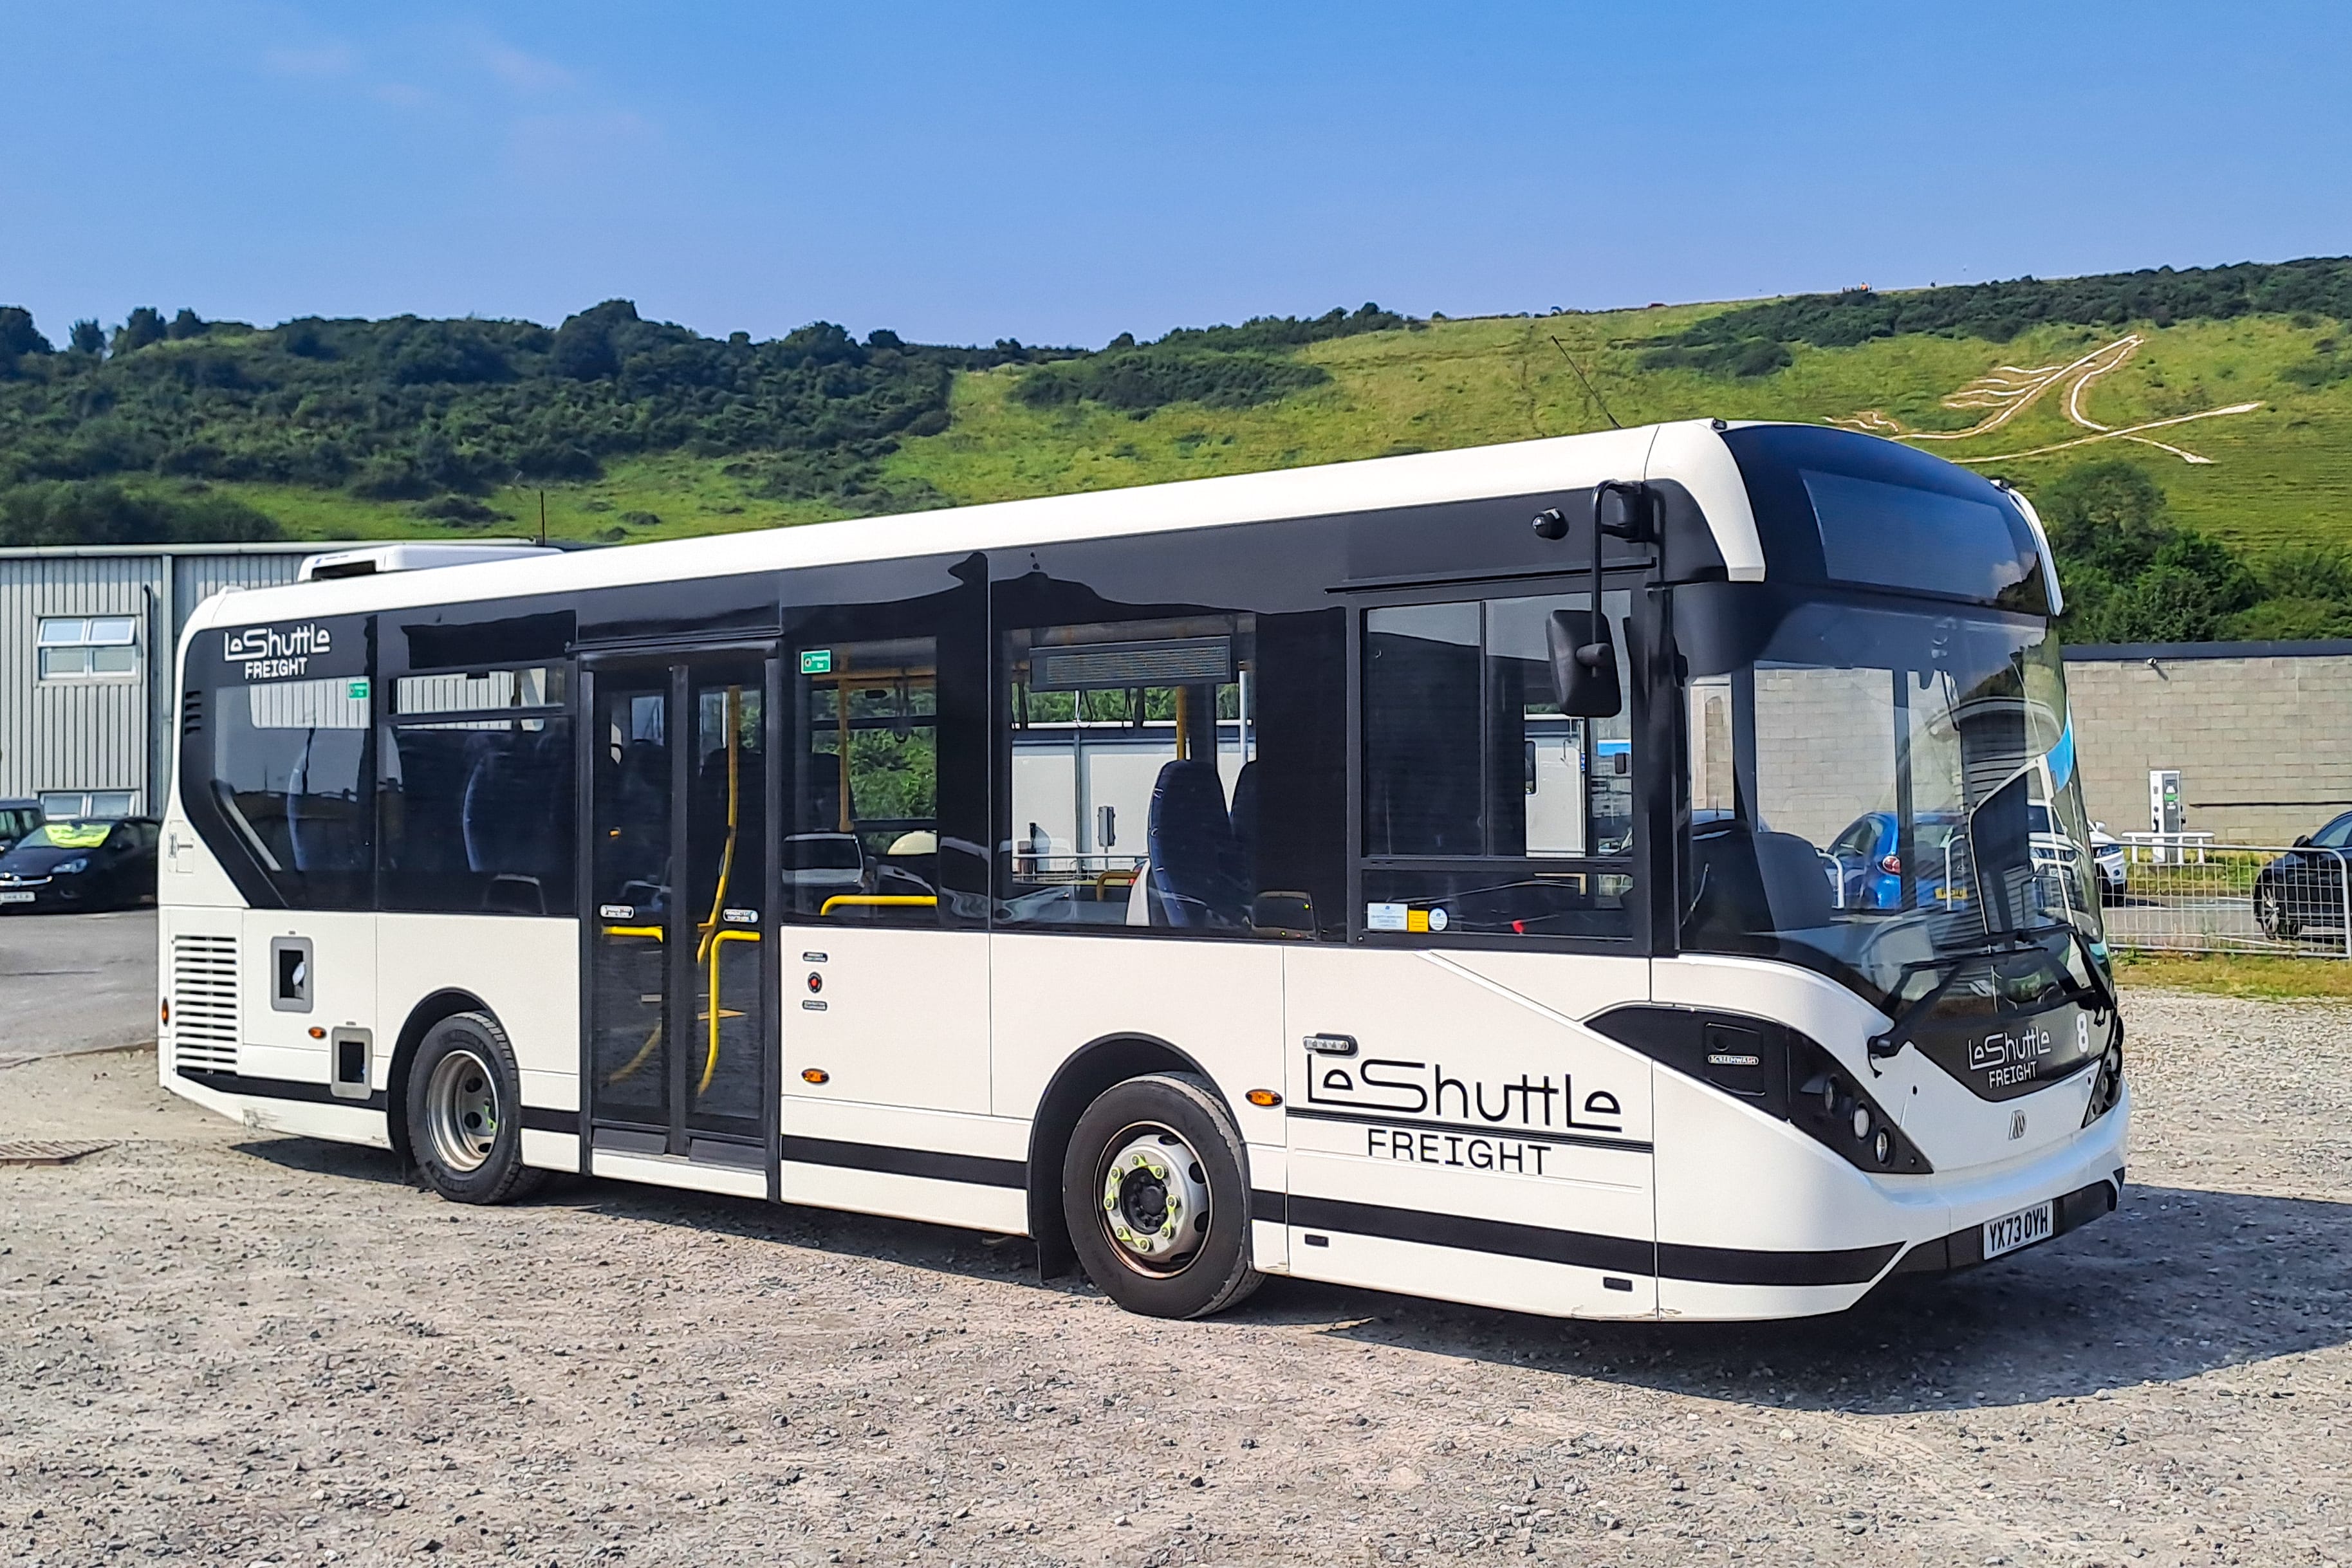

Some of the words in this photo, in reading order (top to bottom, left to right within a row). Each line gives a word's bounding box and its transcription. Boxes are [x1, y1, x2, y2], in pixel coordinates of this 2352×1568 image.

[224, 622, 331, 661] LeShuttle
[245, 656, 308, 680] FREIGHT
[1968, 1026, 2051, 1070] LeShuttle
[2076, 1012, 2089, 1053] 8
[1709, 1055, 1756, 1065] SCREENWASH
[1988, 1060, 2037, 1089] FREIGHT
[1307, 1053, 1622, 1133] LeShuttle
[1367, 1128, 1552, 1176] FREIGHT
[1989, 1215, 2022, 1252] YX73
[2024, 1205, 2048, 1239] OYH
